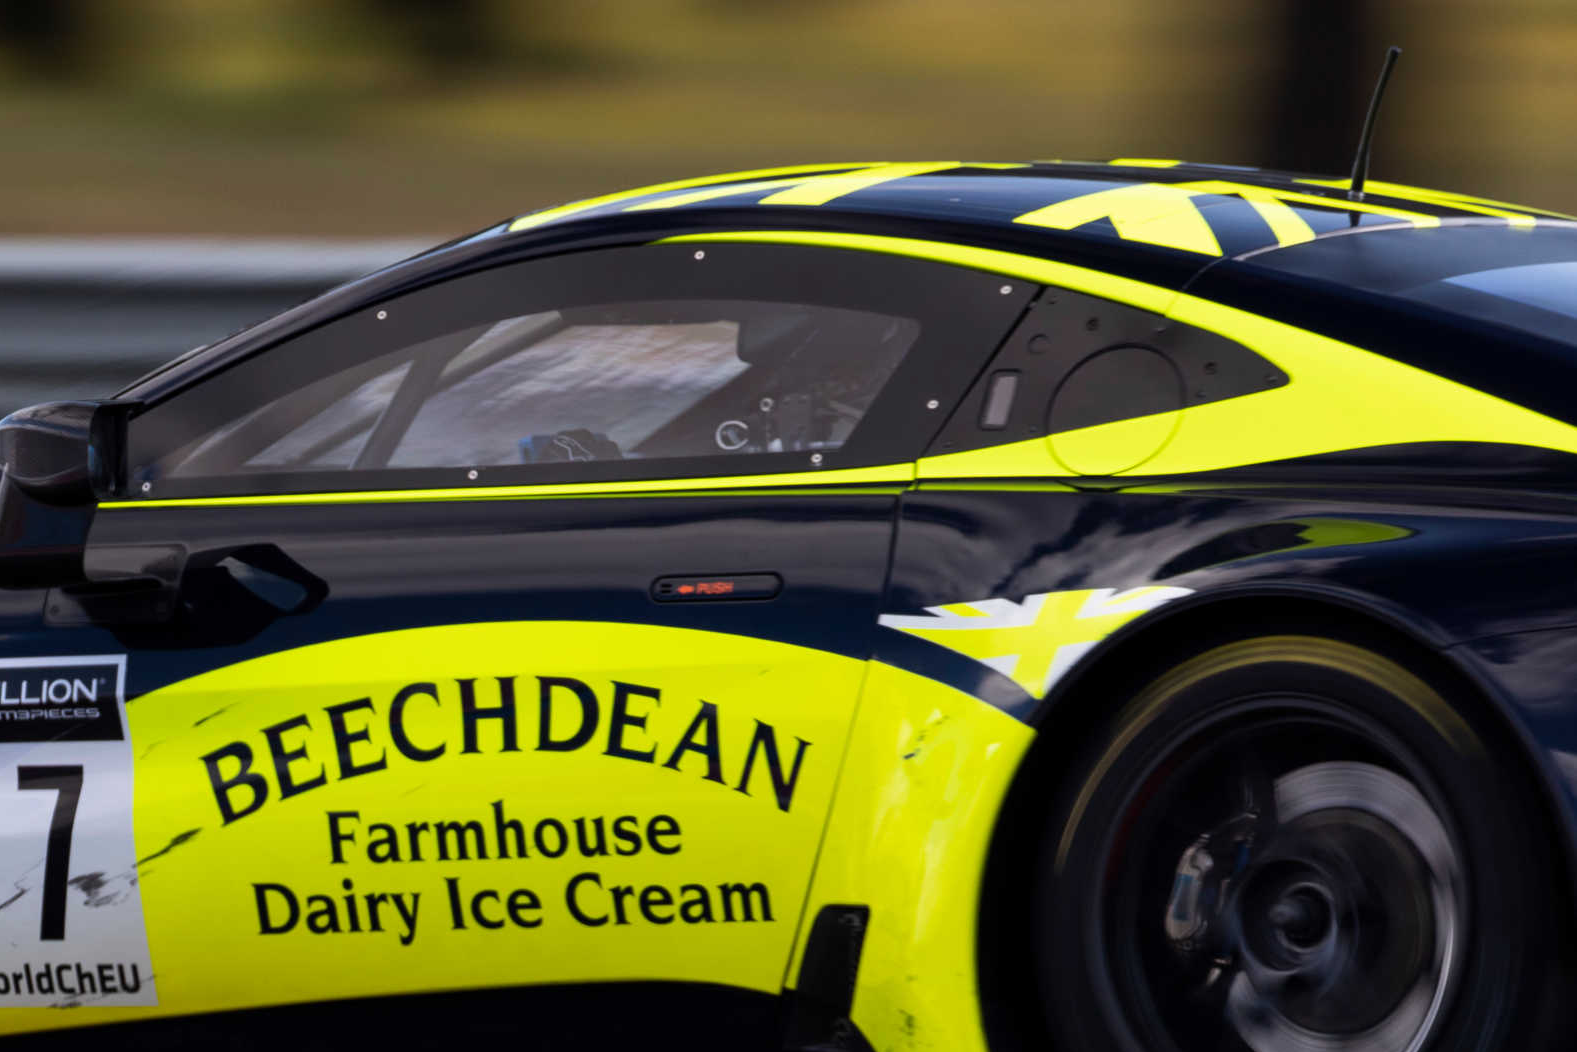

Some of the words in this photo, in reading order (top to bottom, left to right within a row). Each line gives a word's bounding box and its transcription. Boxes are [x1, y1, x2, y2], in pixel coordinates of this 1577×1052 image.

[695, 581, 734, 594] PUSH
[199, 675, 812, 828] BEECHDEAN
[326, 800, 682, 864] Farmhouse
[251, 878, 421, 946] Dairy
[444, 876, 543, 929] Ice
[565, 872, 776, 928] Cream
